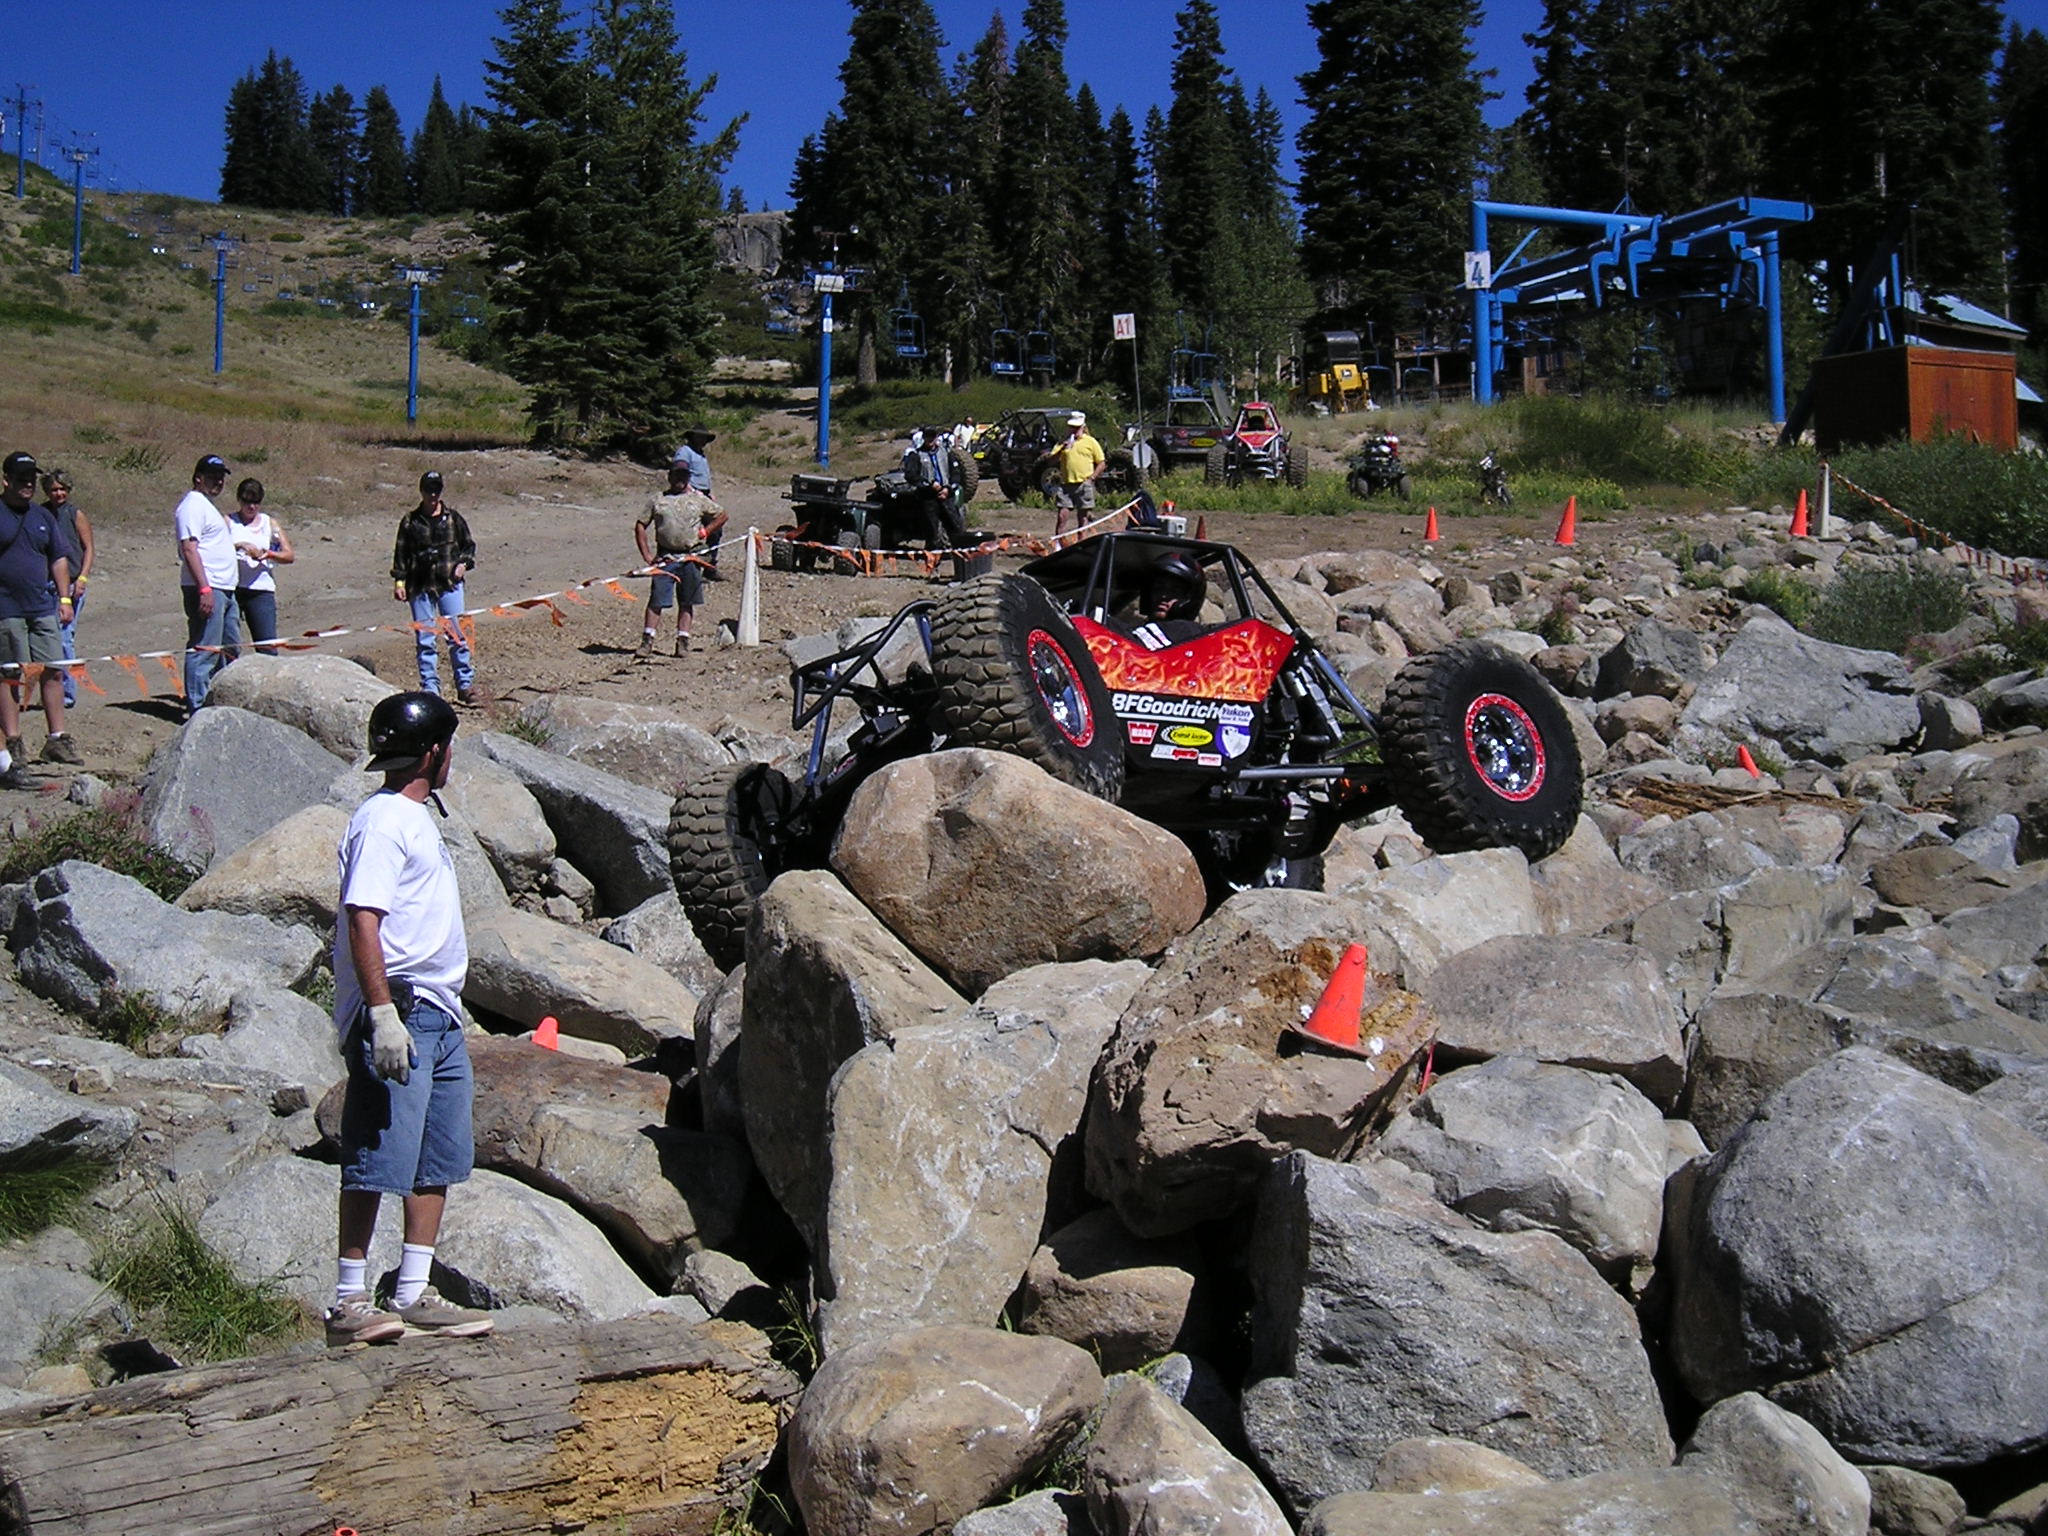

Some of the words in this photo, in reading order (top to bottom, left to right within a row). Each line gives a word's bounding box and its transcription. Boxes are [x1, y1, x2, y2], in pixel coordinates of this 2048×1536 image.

[1471, 261, 1485, 287] 4
[1111, 693, 1219, 719] BFGoodrich
[1222, 707, 1251, 718] Yukon
